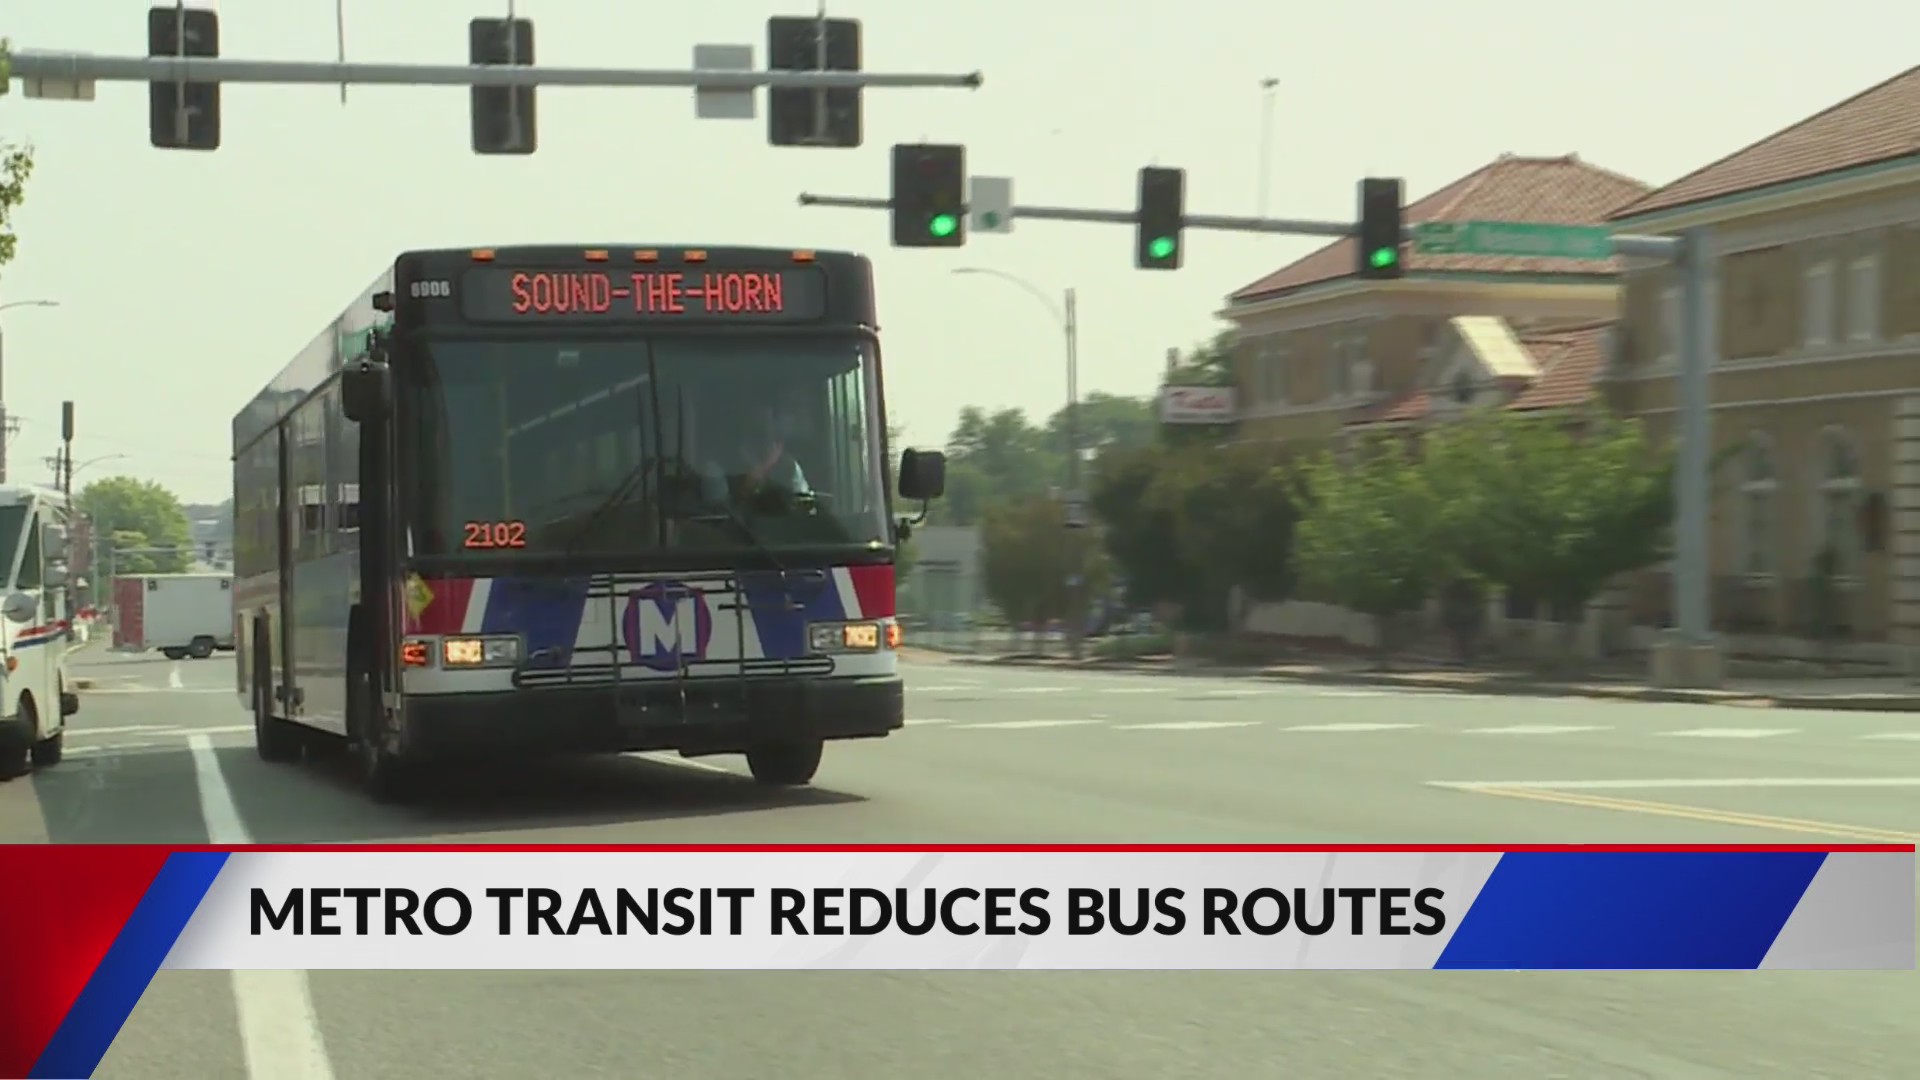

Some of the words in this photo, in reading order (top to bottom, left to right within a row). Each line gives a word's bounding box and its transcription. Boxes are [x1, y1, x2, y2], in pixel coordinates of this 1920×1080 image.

[512, 273, 783, 313] SOUND-THE-HORN
[464, 523, 526, 548] 2102
[639, 598, 697, 657] M
